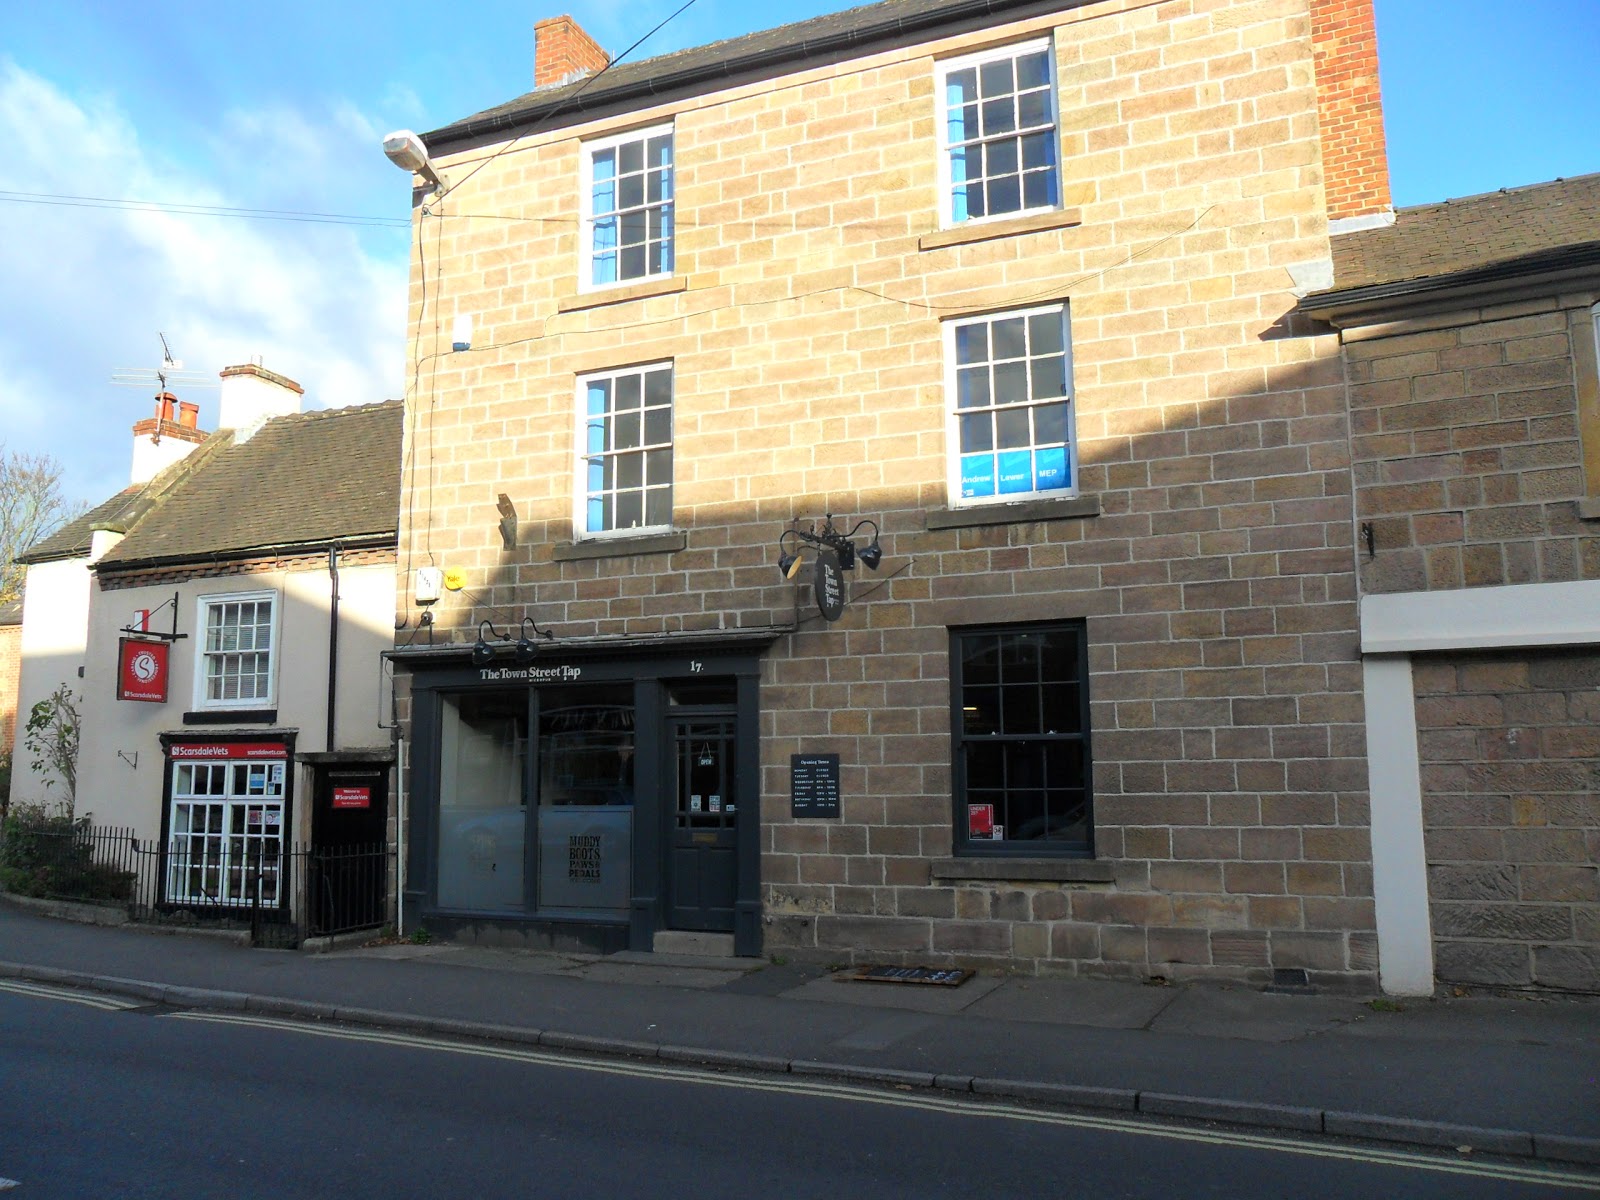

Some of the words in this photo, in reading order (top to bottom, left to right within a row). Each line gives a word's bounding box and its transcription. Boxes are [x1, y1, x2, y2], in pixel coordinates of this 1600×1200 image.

[961, 475, 991, 484] Andrew
[1038, 469, 1057, 477] MEP
[480, 669, 500, 680] The
[500, 668, 528, 678] Town
[528, 666, 560, 678] Street
[561, 666, 580, 680] Tap
[570, 836, 600, 847] MUDDY
[570, 860, 594, 868] PAWS
[569, 869, 600, 878] PEDALS
